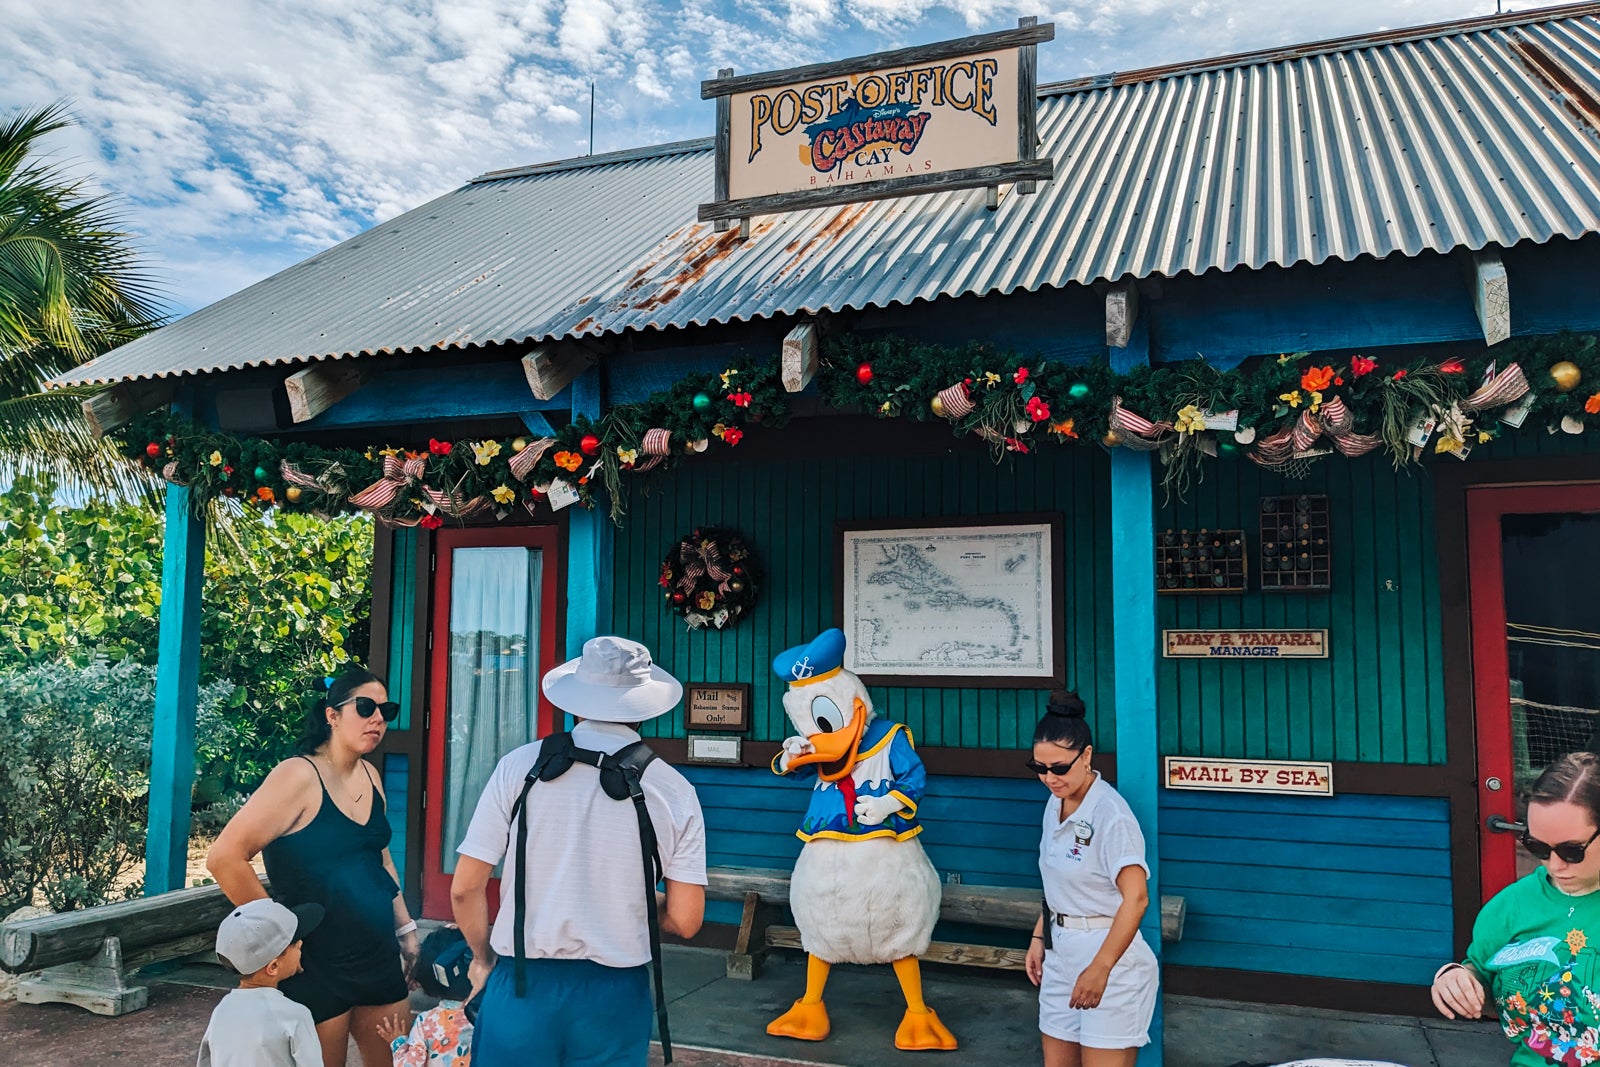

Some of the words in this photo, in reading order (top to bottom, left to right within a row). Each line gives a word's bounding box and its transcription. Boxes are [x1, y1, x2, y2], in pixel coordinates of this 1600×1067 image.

[748, 81, 848, 164] POST
[854, 58, 997, 126] OFFICE
[872, 107, 901, 119] Disney's
[811, 111, 931, 173] Castaway
[854, 147, 893, 167] CAY
[810, 160, 933, 185] BAHAMAS
[1176, 633, 1215, 646] MAY
[1220, 633, 1234, 646] B.
[1239, 633, 1316, 646] TAMARA
[1210, 646, 1279, 656] MANAGER
[696, 690, 718, 701] Mail
[721, 704, 740, 712] Stamps
[706, 714, 725, 723] Only!
[1178, 766, 1233, 783] MAIL
[1239, 768, 1269, 785] BY
[1276, 770, 1321, 786] SEA
